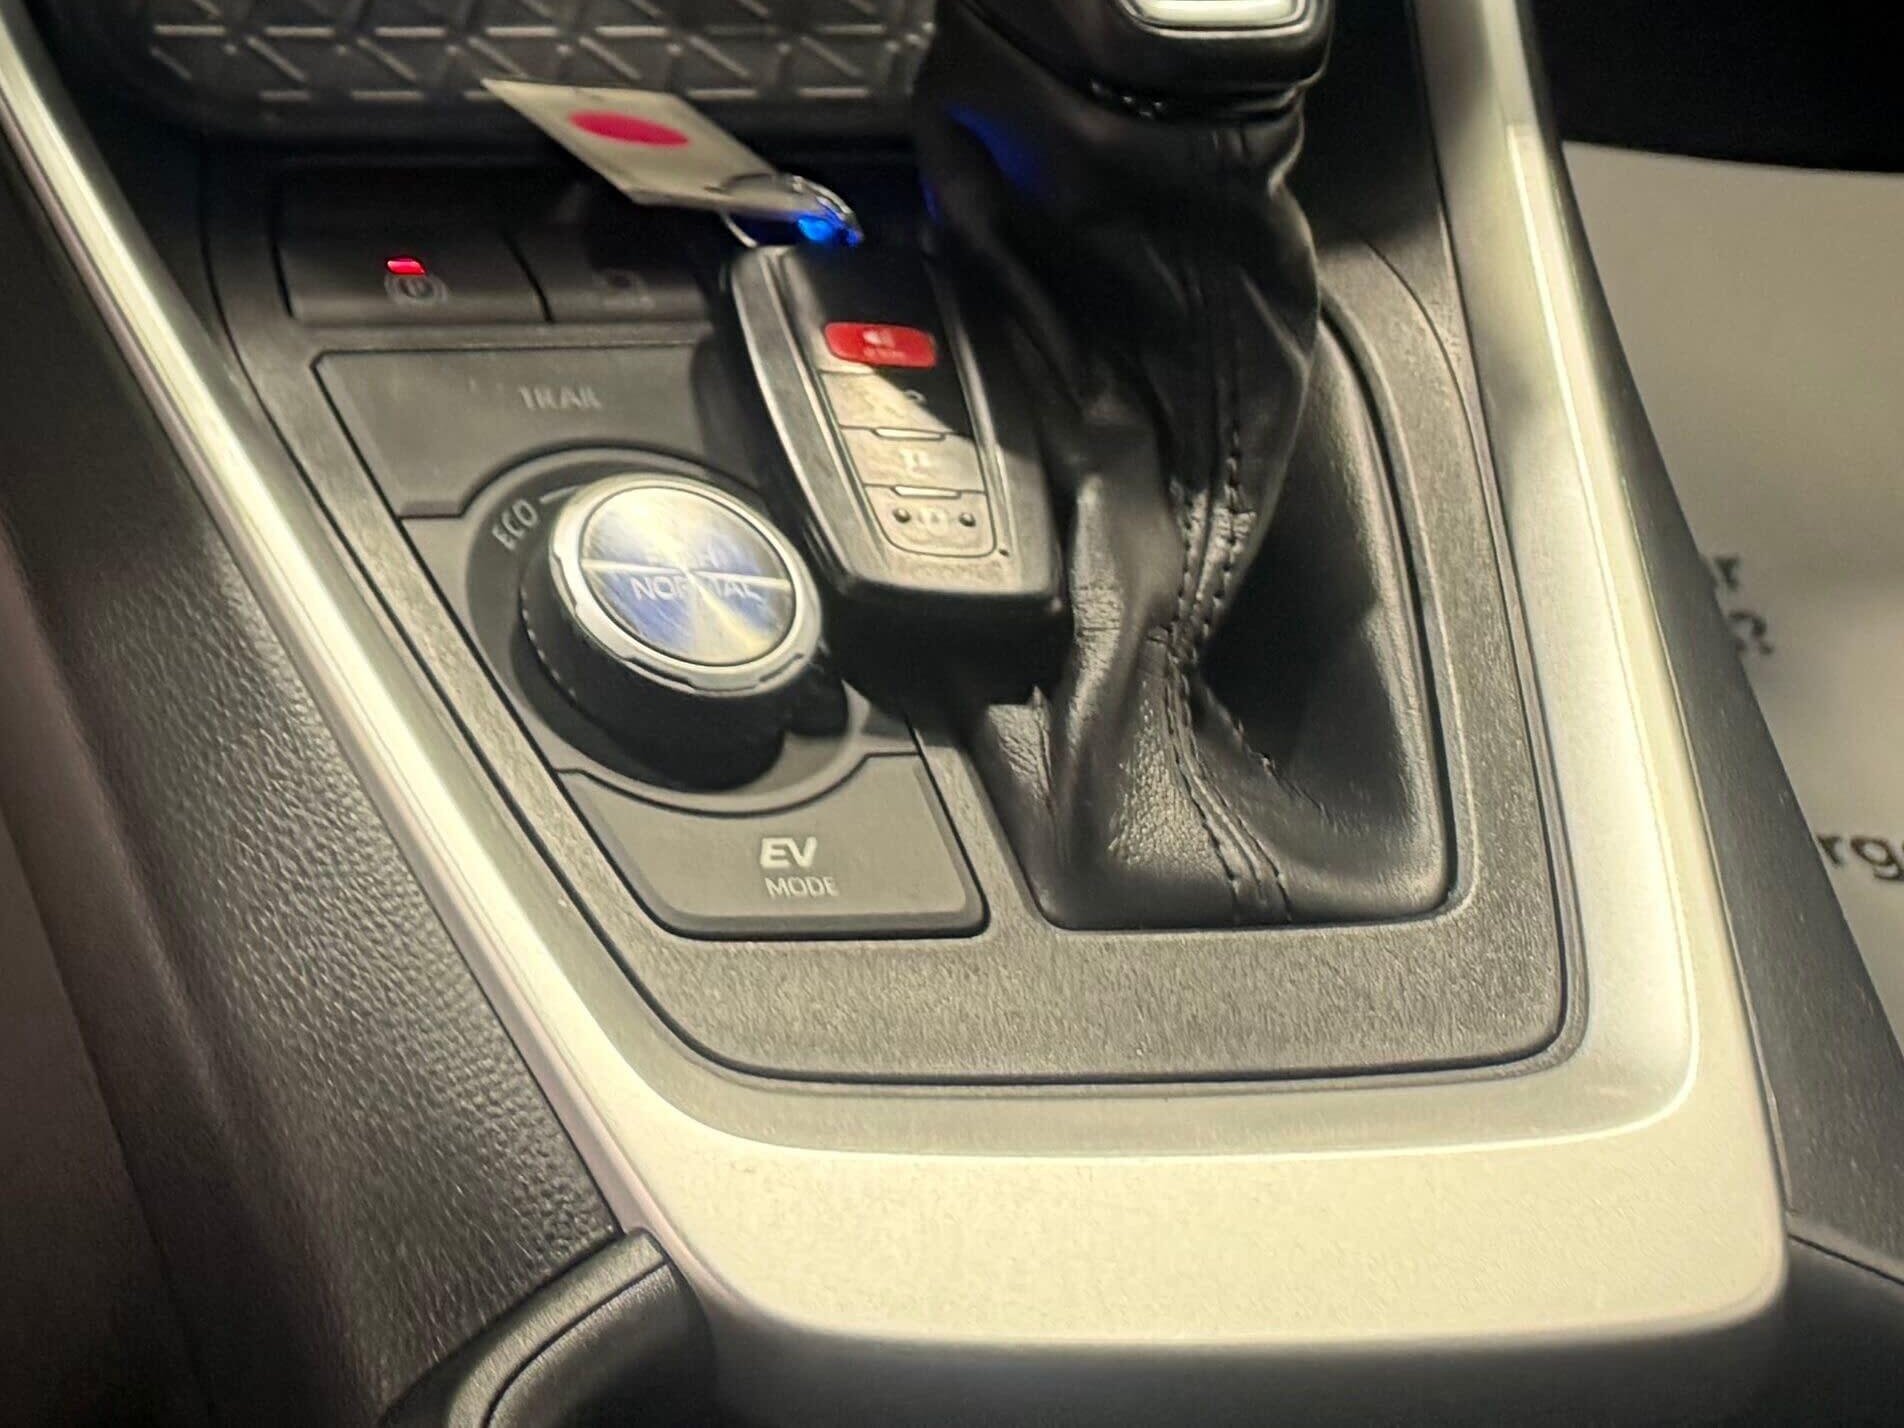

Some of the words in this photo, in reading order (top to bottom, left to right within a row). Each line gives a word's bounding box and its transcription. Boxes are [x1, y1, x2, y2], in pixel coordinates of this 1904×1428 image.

[492, 498, 540, 551] ECO
[760, 836, 818, 871] EV
[765, 874, 839, 899] MODE
